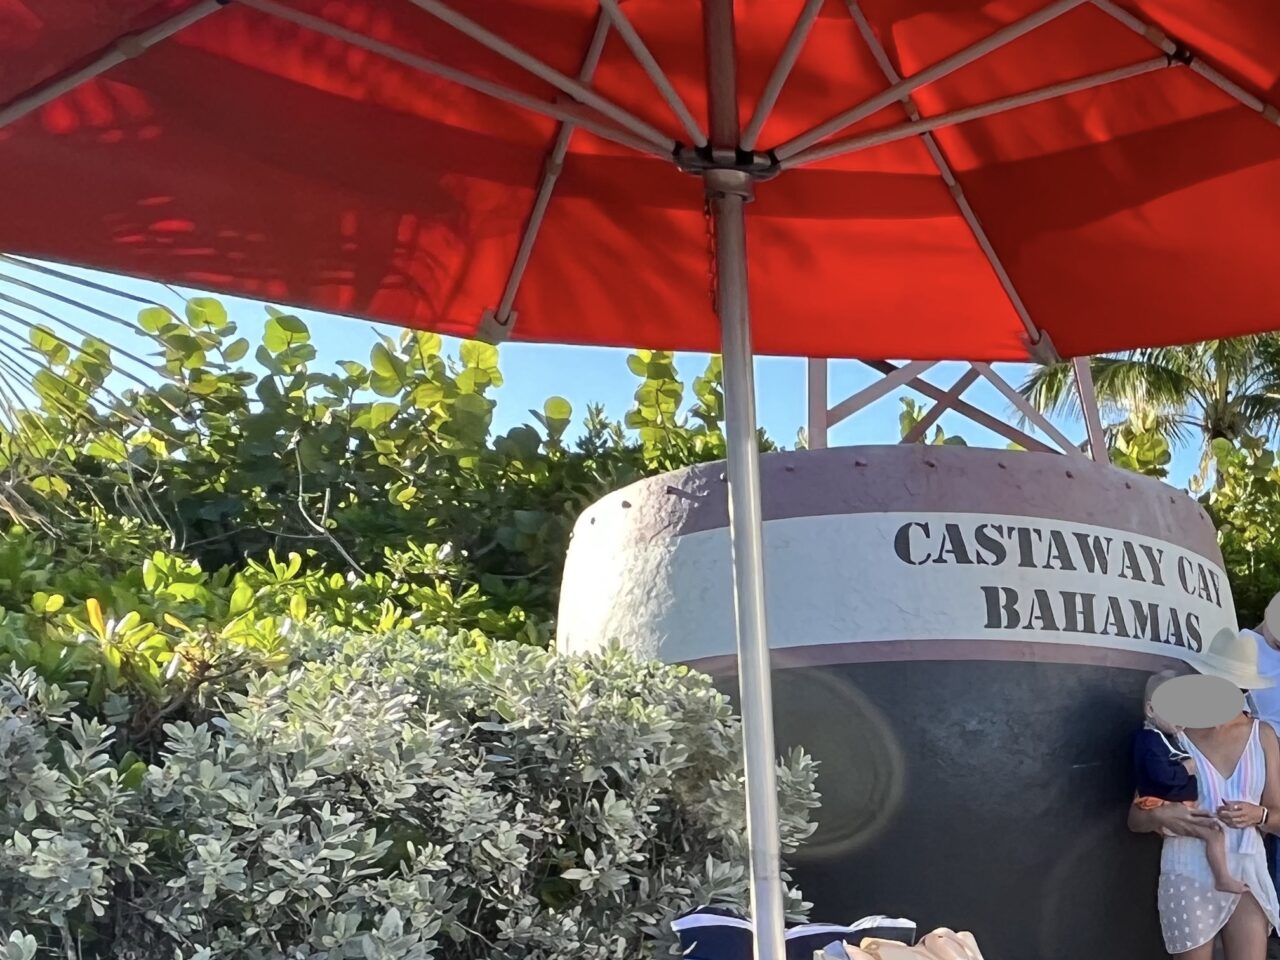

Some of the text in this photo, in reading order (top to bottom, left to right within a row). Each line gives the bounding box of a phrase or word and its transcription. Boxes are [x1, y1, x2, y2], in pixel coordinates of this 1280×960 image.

[893, 521, 1223, 609] CASTAWAY CAY
[980, 585, 1203, 654] BAHAMAS
